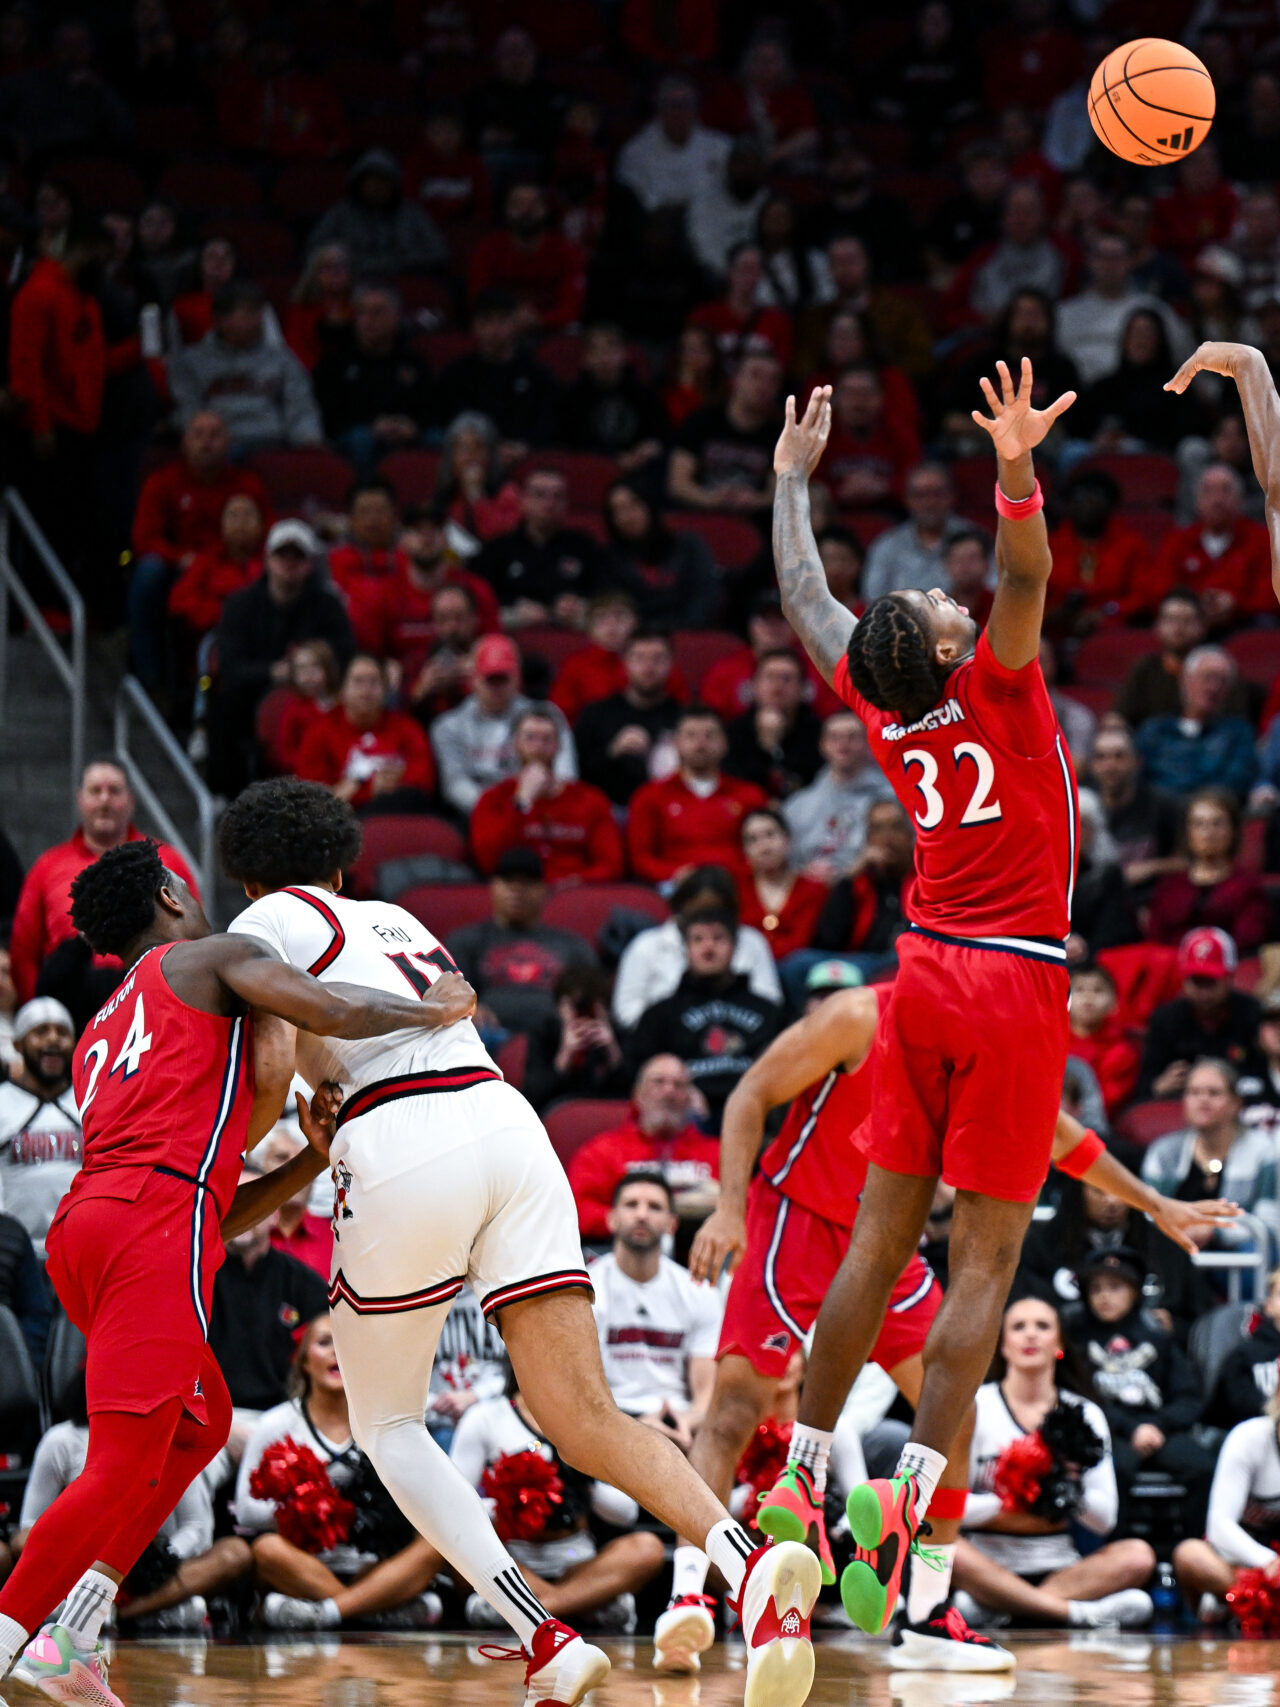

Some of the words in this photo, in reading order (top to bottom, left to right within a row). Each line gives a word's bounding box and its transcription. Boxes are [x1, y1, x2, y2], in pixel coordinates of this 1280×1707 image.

[902, 741, 1002, 832] 32
[372, 924, 412, 944] FRU
[93, 971, 137, 1030] FULTON
[79, 991, 153, 1125] 24
